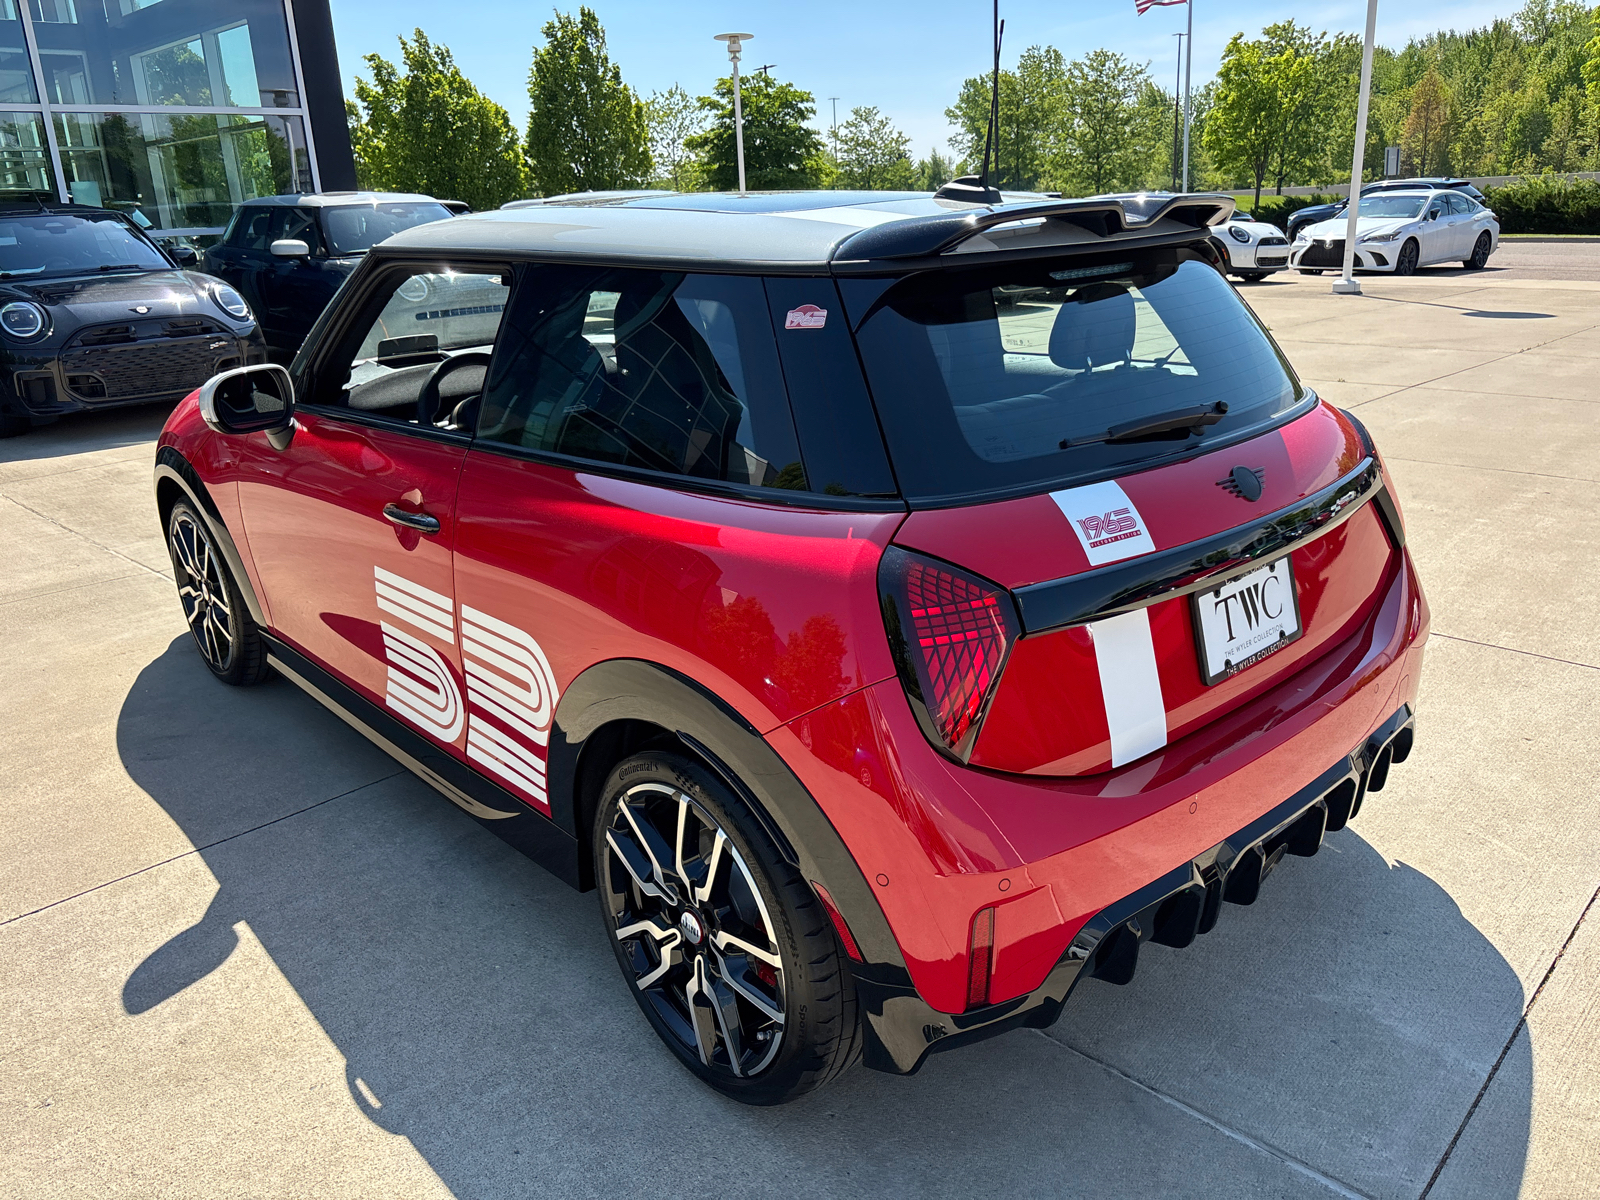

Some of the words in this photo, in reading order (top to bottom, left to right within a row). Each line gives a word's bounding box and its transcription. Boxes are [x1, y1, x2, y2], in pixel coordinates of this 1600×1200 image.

[1076, 507, 1137, 541] 1965
[1089, 537, 1116, 548] VICTORY
[1117, 530, 1142, 541] EDITION
[1214, 575, 1283, 643] TWC
[1224, 649, 1235, 659] THE
[1236, 640, 1252, 653] WYLER
[1253, 623, 1284, 644] COLLECTION
[1226, 666, 1238, 677] THE
[1239, 655, 1257, 671] WYLER
[1256, 637, 1290, 661] COLLECTION
